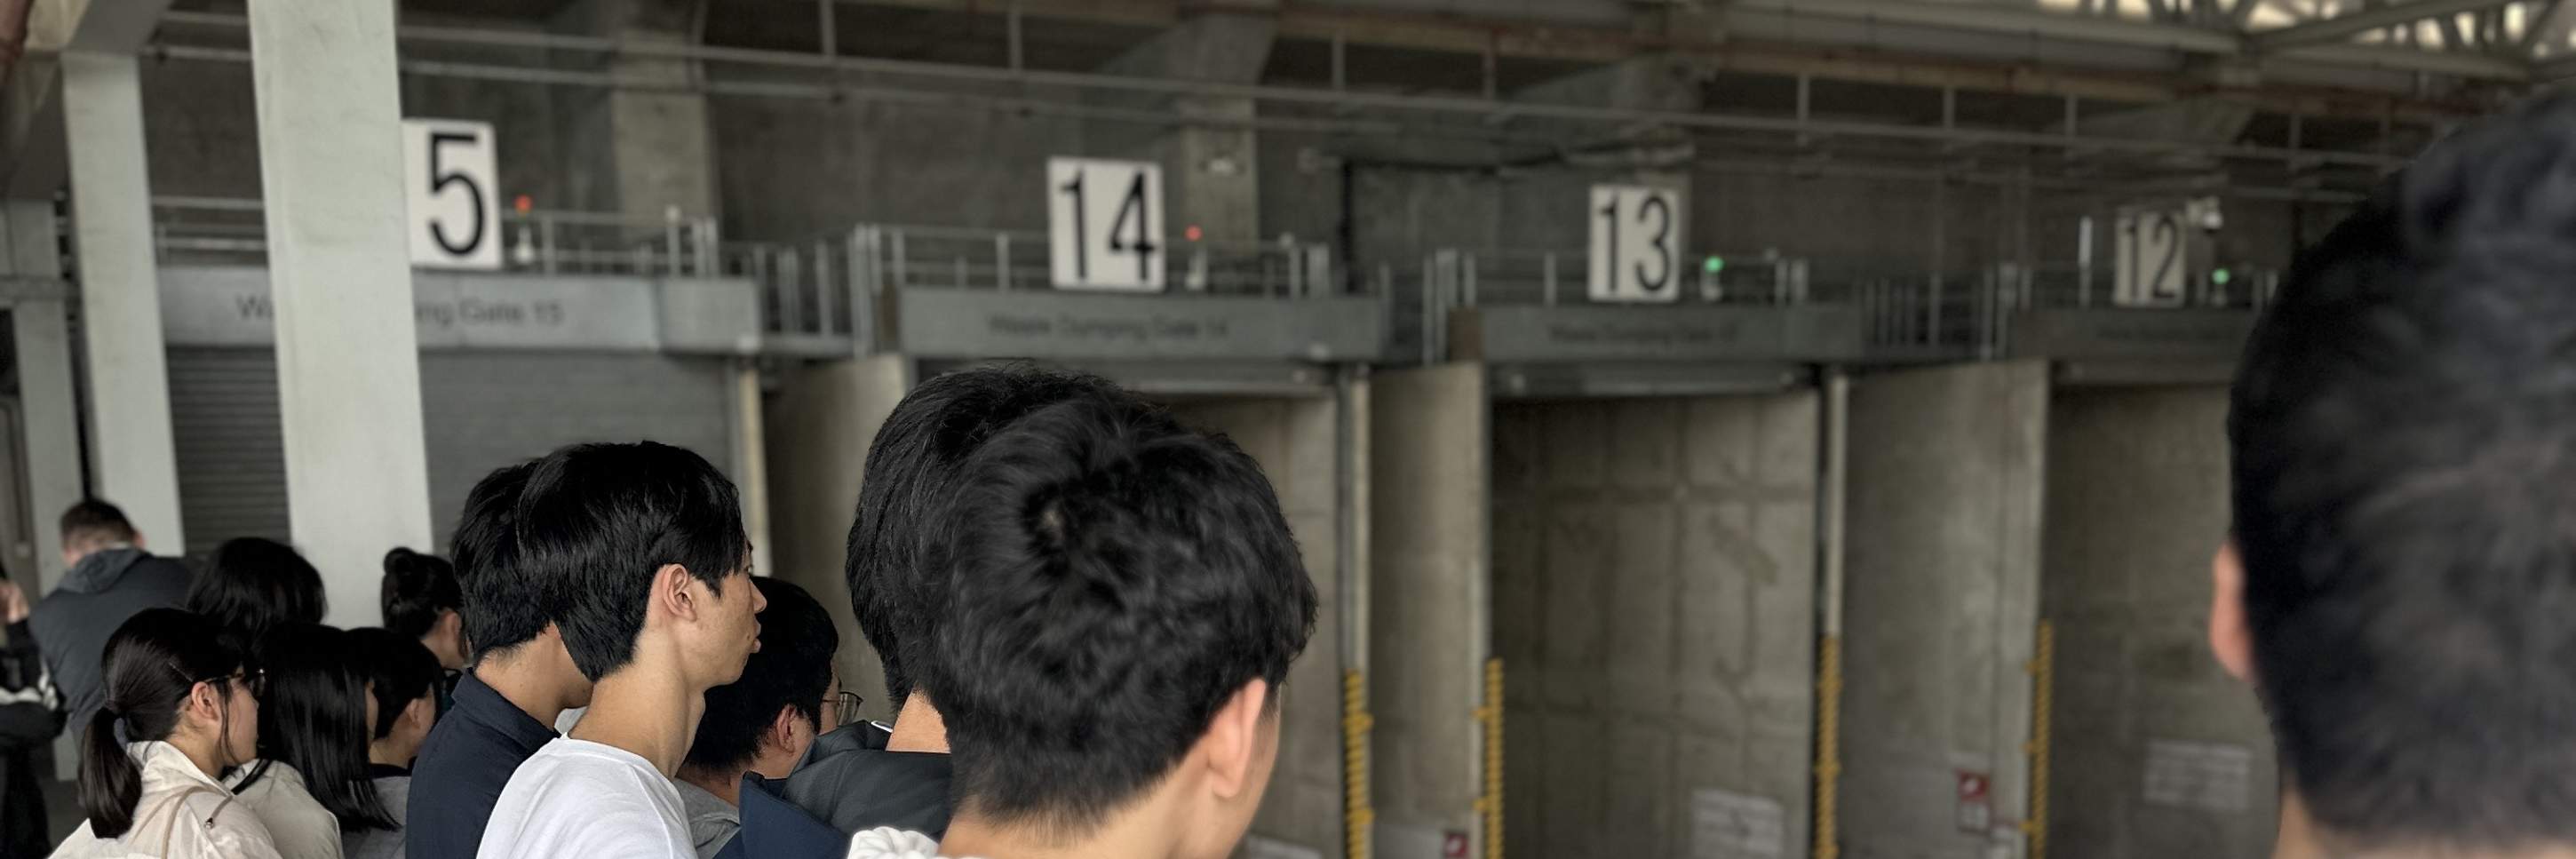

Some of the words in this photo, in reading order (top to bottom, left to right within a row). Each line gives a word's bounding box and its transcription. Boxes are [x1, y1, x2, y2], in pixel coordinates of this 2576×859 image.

[430, 133, 484, 256] 5
[1061, 169, 1157, 281] 14
[1598, 195, 1671, 292] 13
[2124, 215, 2177, 298] 12
